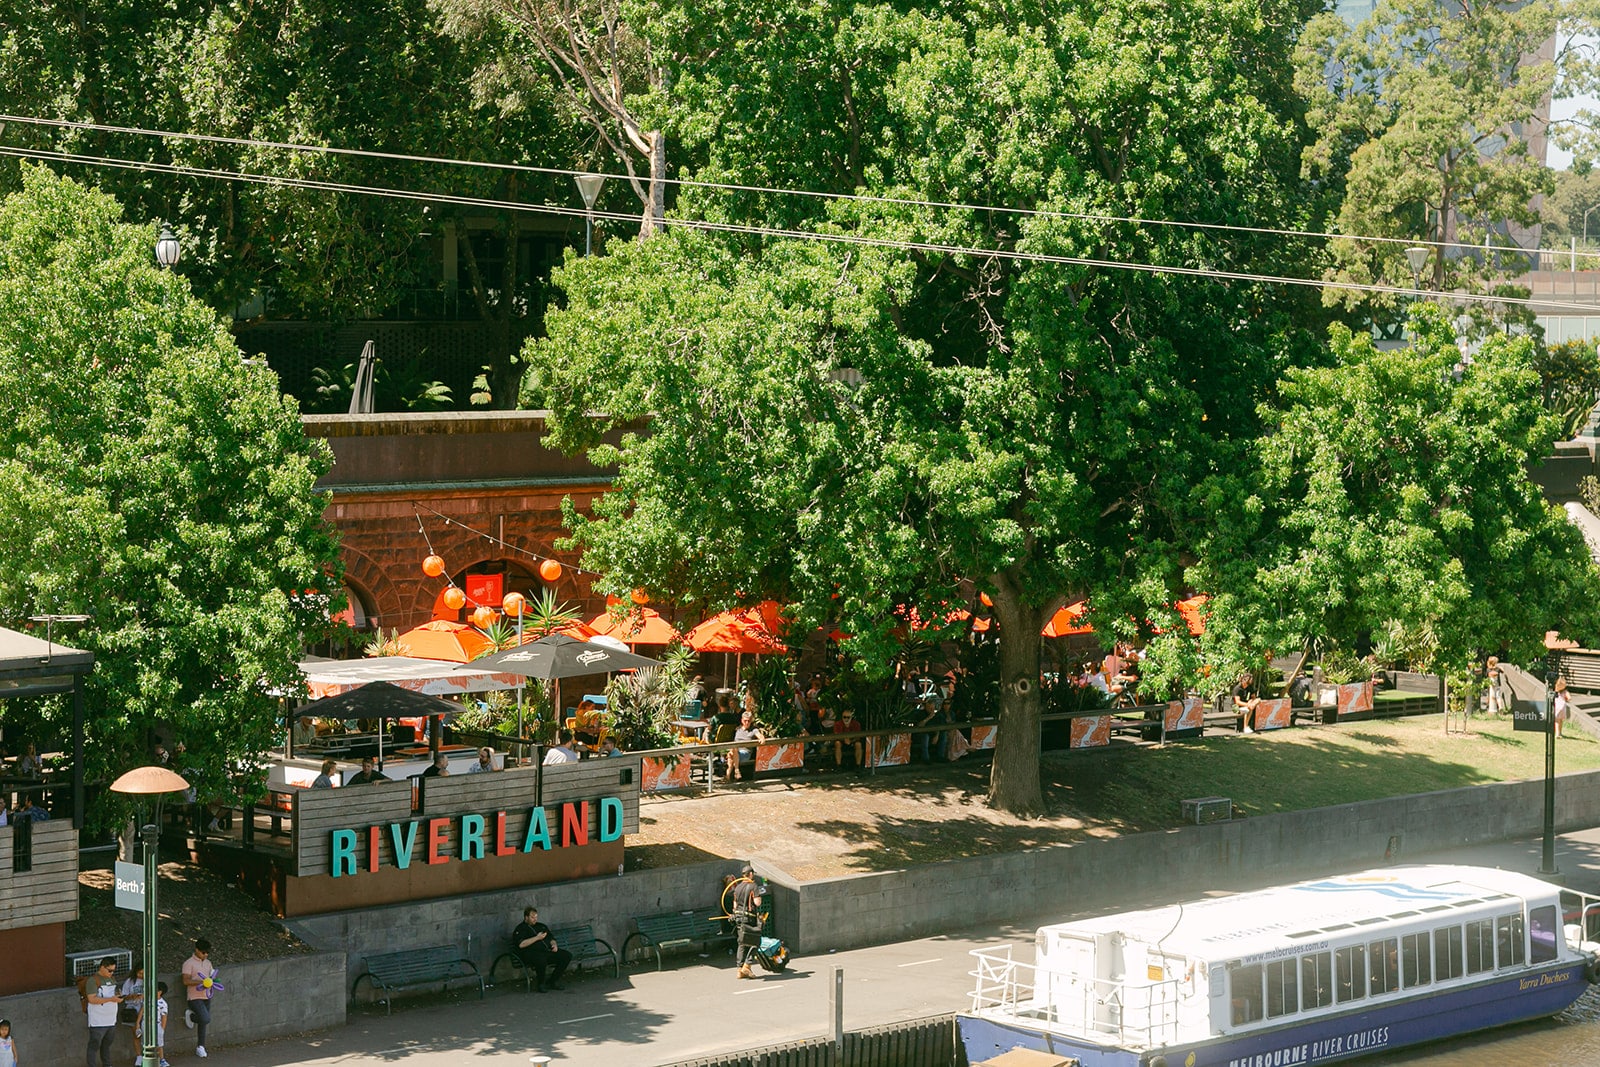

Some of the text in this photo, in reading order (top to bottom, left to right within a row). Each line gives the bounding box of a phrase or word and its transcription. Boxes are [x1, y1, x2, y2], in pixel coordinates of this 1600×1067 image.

[1514, 711, 1545, 721] Berth 3
[331, 797, 624, 878] RIVERLAND
[116, 878, 145, 895] Berth 2
[1519, 971, 1570, 991] Yarra Duchess
[1312, 1037, 1342, 1058] RIVER
[1346, 1026, 1389, 1051] CRUISES
